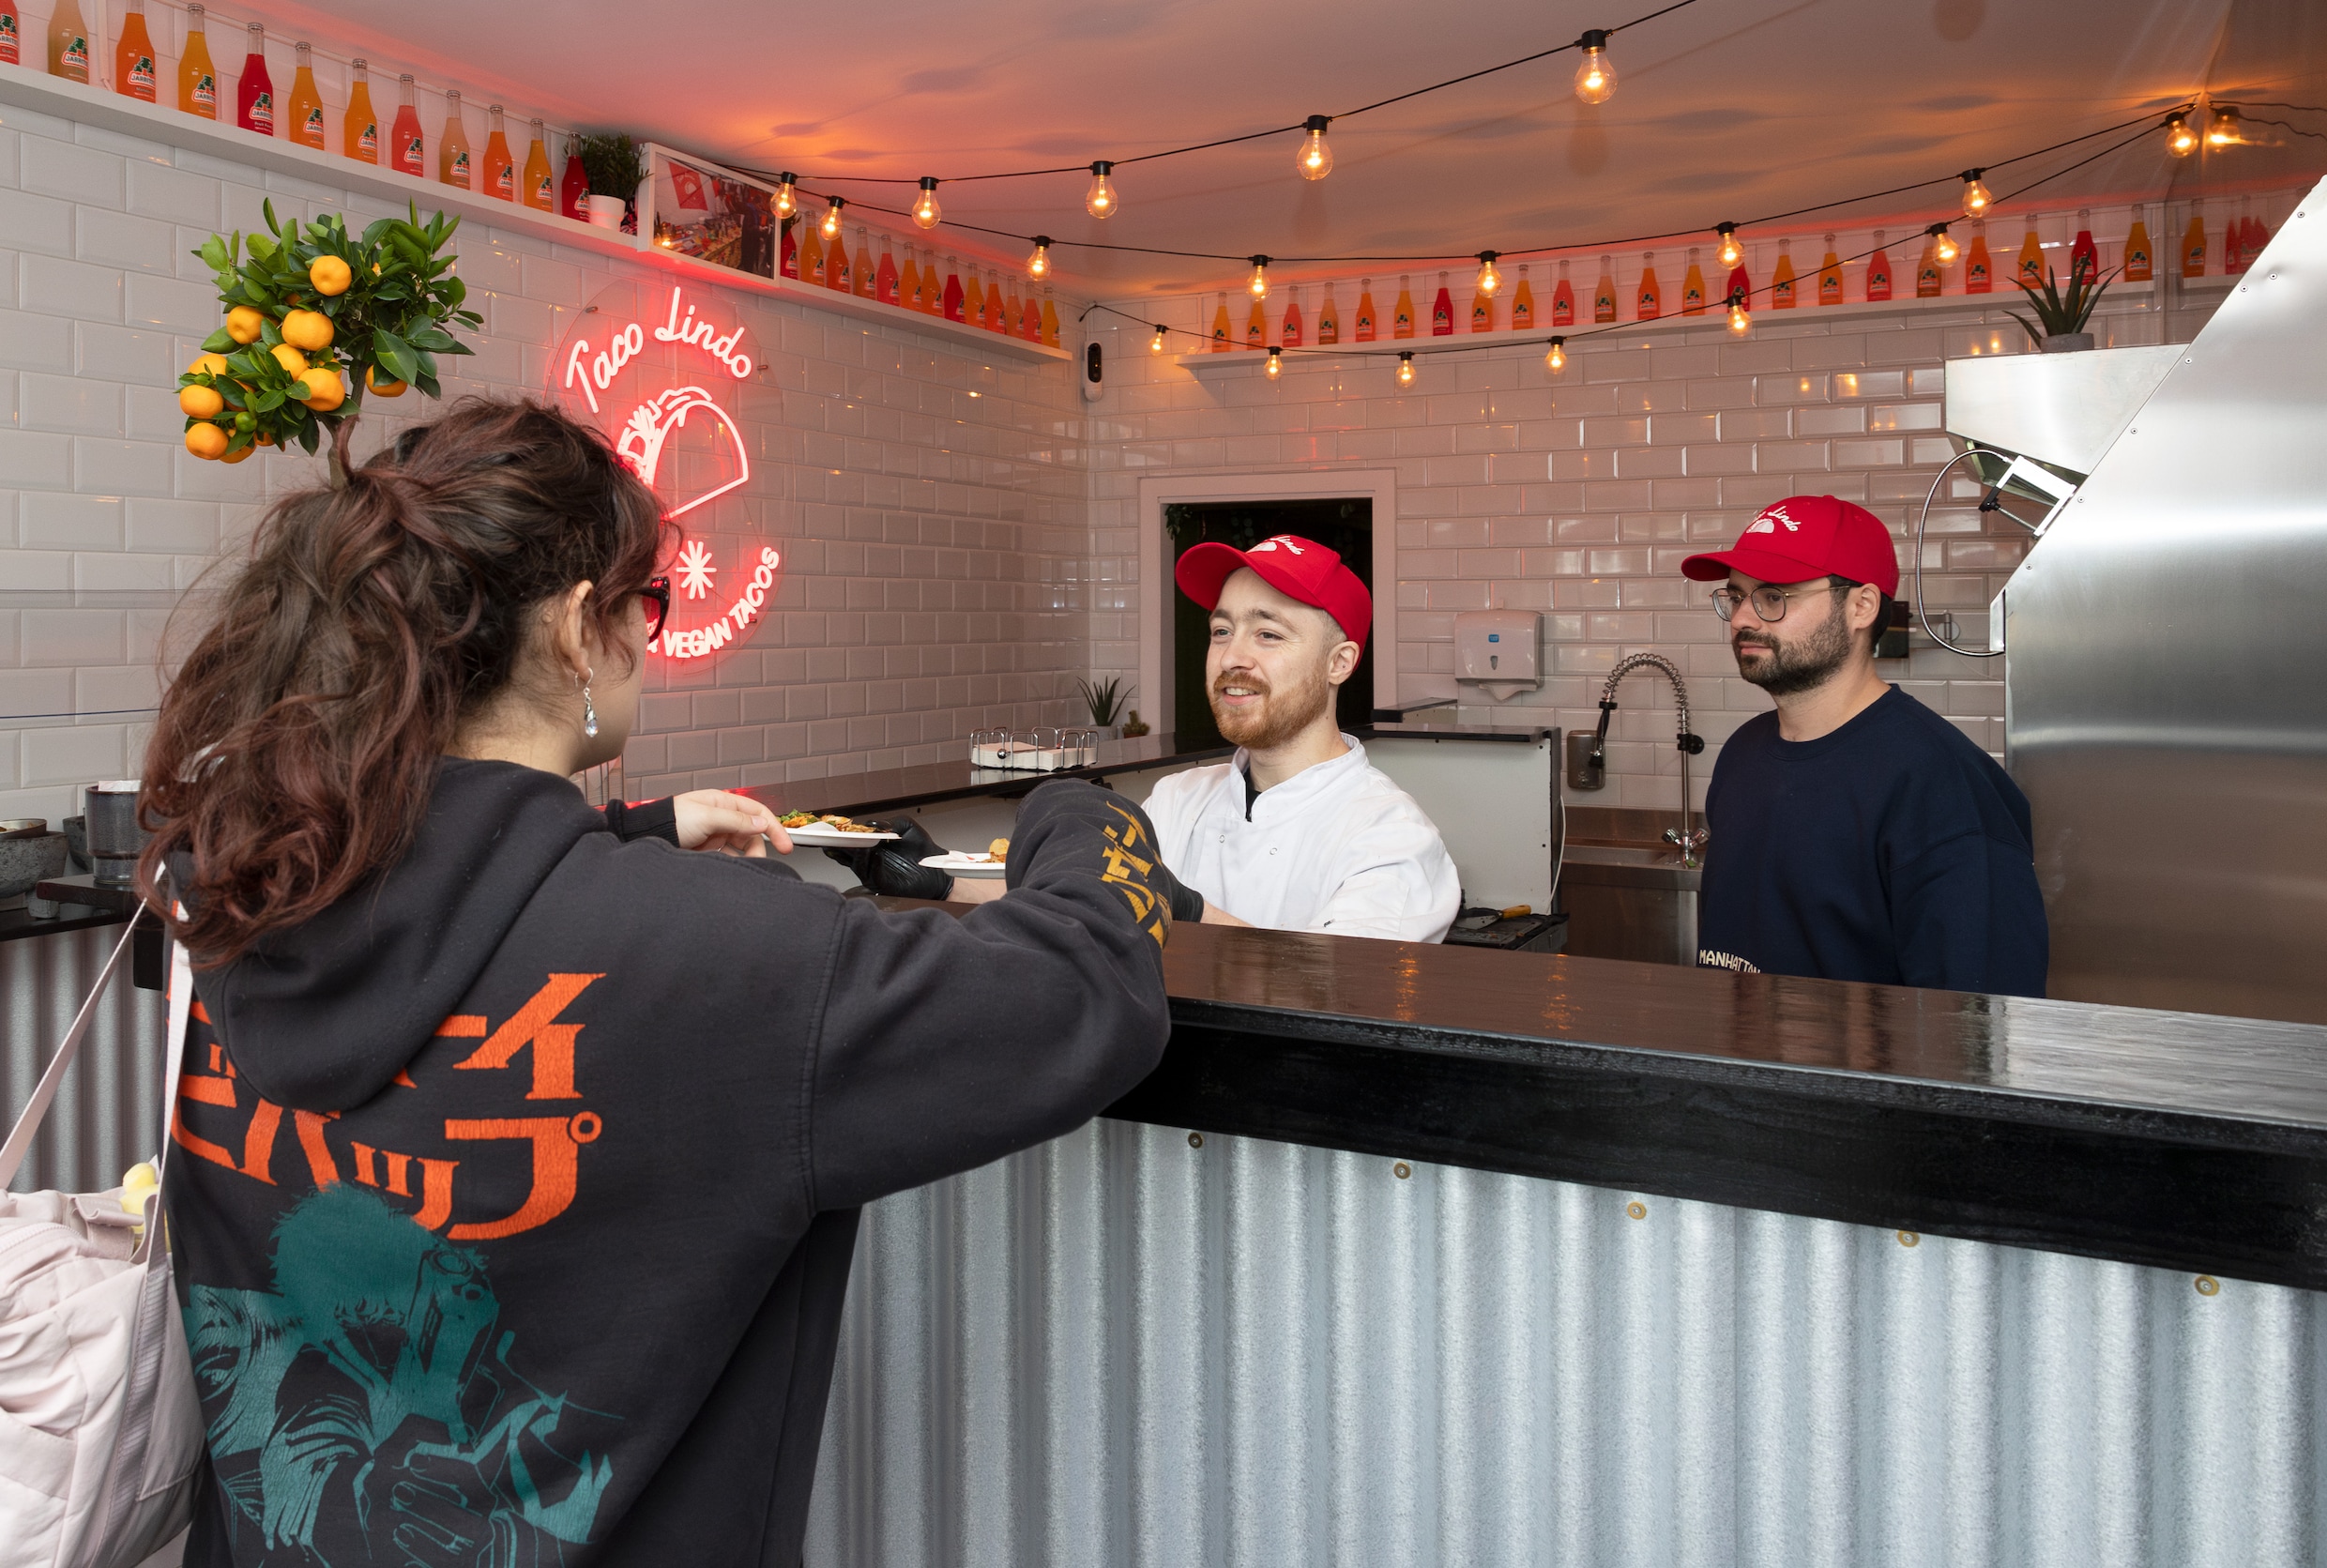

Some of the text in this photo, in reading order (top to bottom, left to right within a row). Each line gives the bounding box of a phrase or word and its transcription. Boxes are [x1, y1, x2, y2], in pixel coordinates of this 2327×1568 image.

[566, 286, 752, 414] Taco Lindo
[662, 616, 733, 658] VEGAN
[728, 546, 780, 630] TACOS
